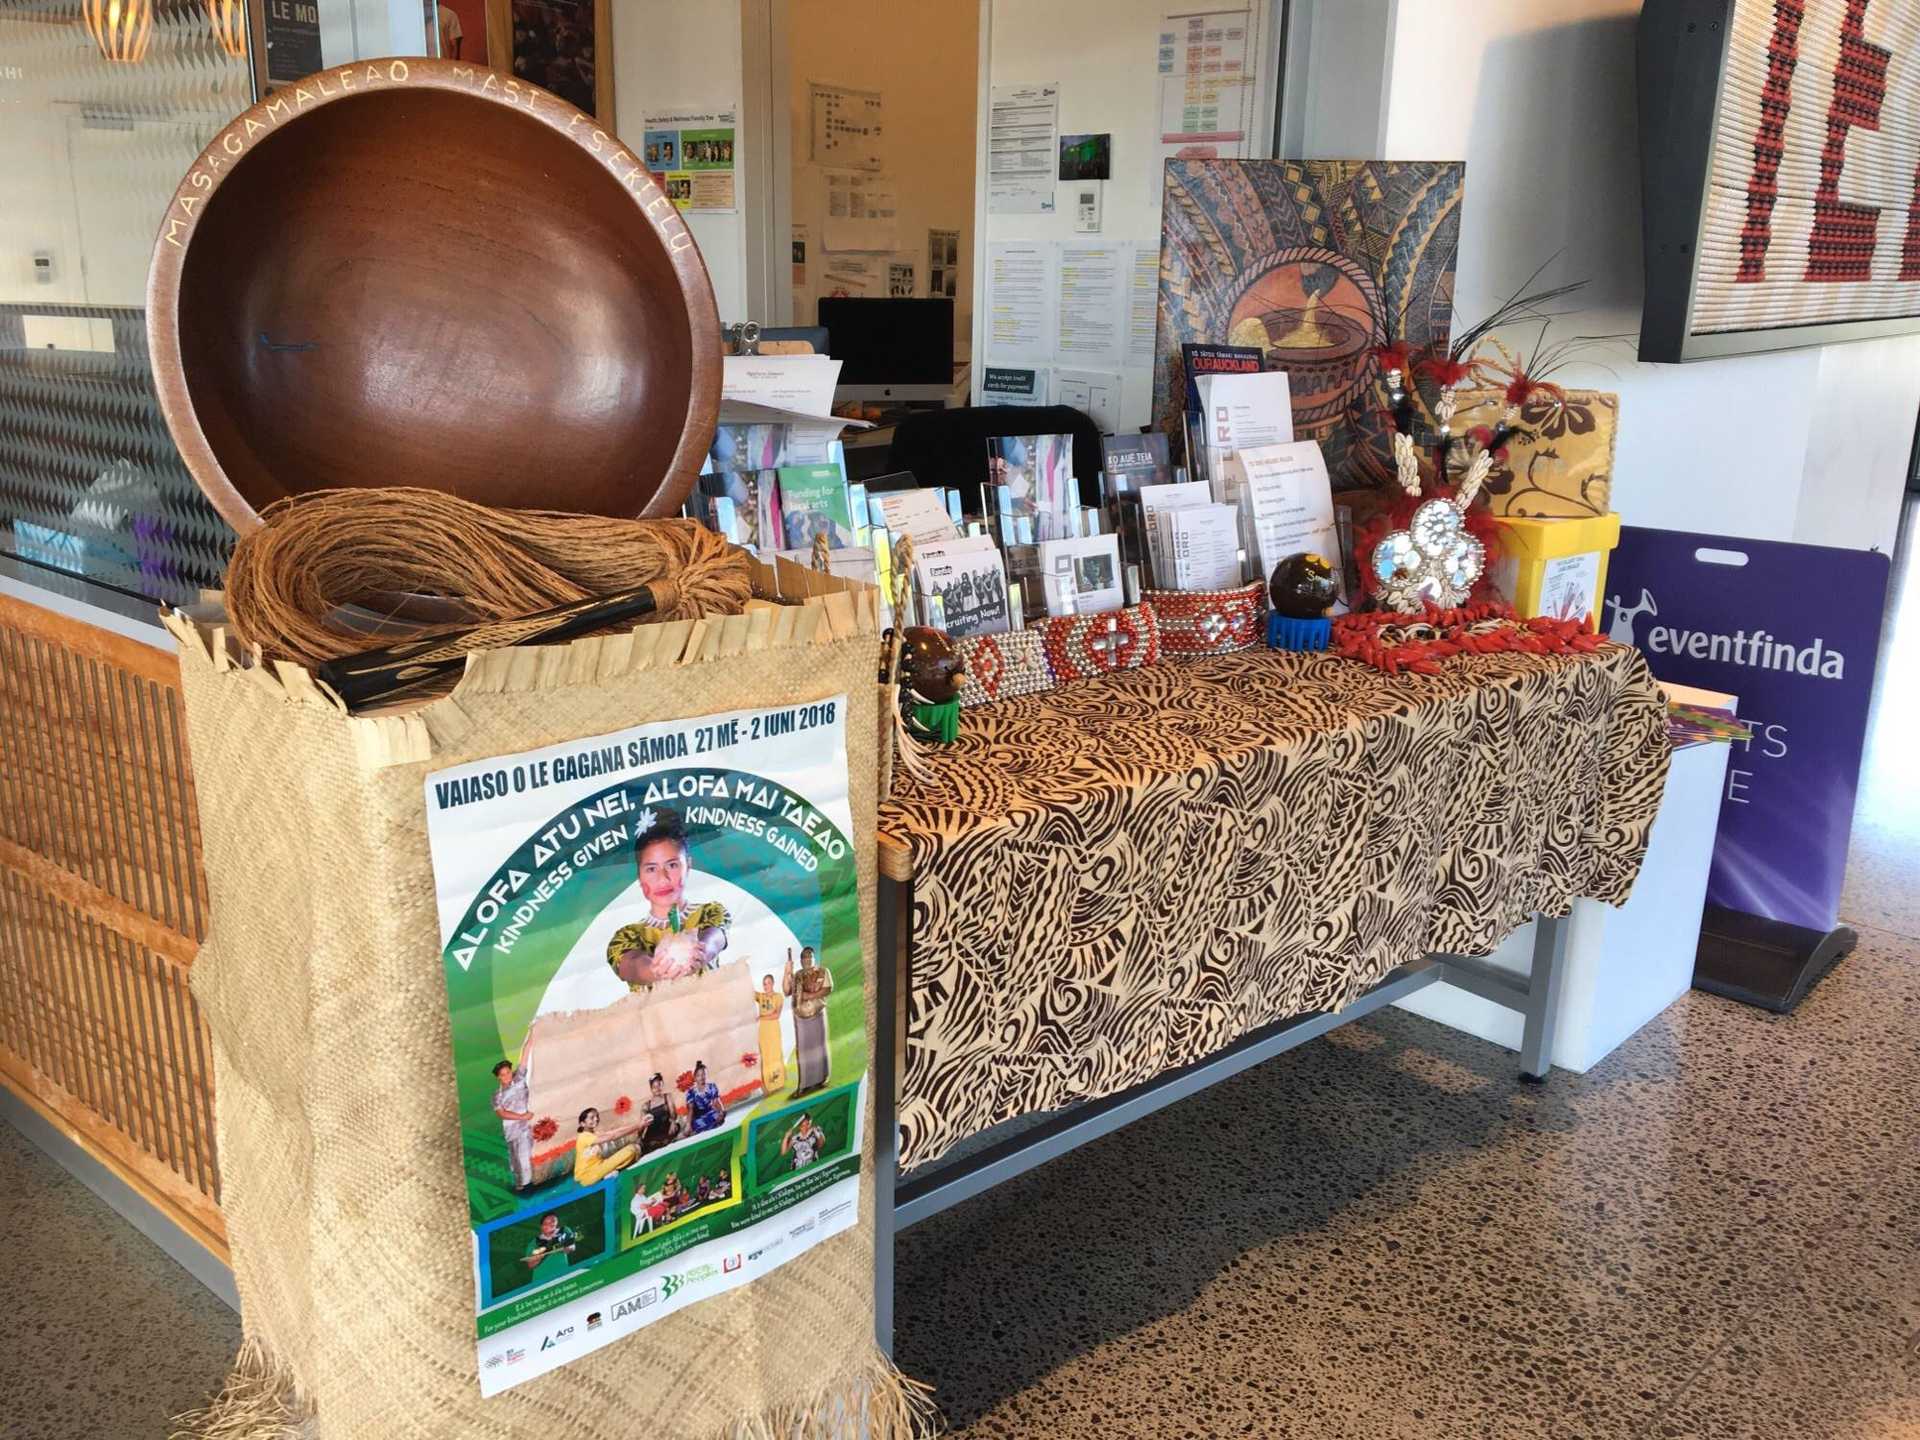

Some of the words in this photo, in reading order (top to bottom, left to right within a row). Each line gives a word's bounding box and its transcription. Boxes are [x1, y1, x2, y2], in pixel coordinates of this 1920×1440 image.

[453, 66, 540, 110] MASI
[565, 113, 693, 254] ESEKIELU
[945, 613, 979, 628] cruiting
[1648, 625, 1845, 680] eventfinda
[435, 770, 509, 810] VAIASO
[513, 765, 526, 793] O
[530, 760, 549, 790] LE
[553, 748, 624, 784] GAGANA
[627, 731, 688, 766] SĀMOA
[695, 727, 715, 754] 27
[717, 719, 739, 751] MĒ
[751, 717, 761, 742] 2
[764, 708, 797, 738] IUNI
[799, 702, 836, 730] 2018
[1739, 718, 1788, 758] TS
[452, 867, 532, 971] ALOFA
[532, 813, 582, 867] ATU
[643, 775, 730, 804] ALOFA
[736, 780, 779, 810] MAI
[781, 794, 846, 860] TAEAO
[494, 860, 573, 955] KINDNESS
[574, 824, 629, 867] GIVEN
[685, 806, 764, 836] KINDNESS
[766, 826, 819, 873] GAINED
